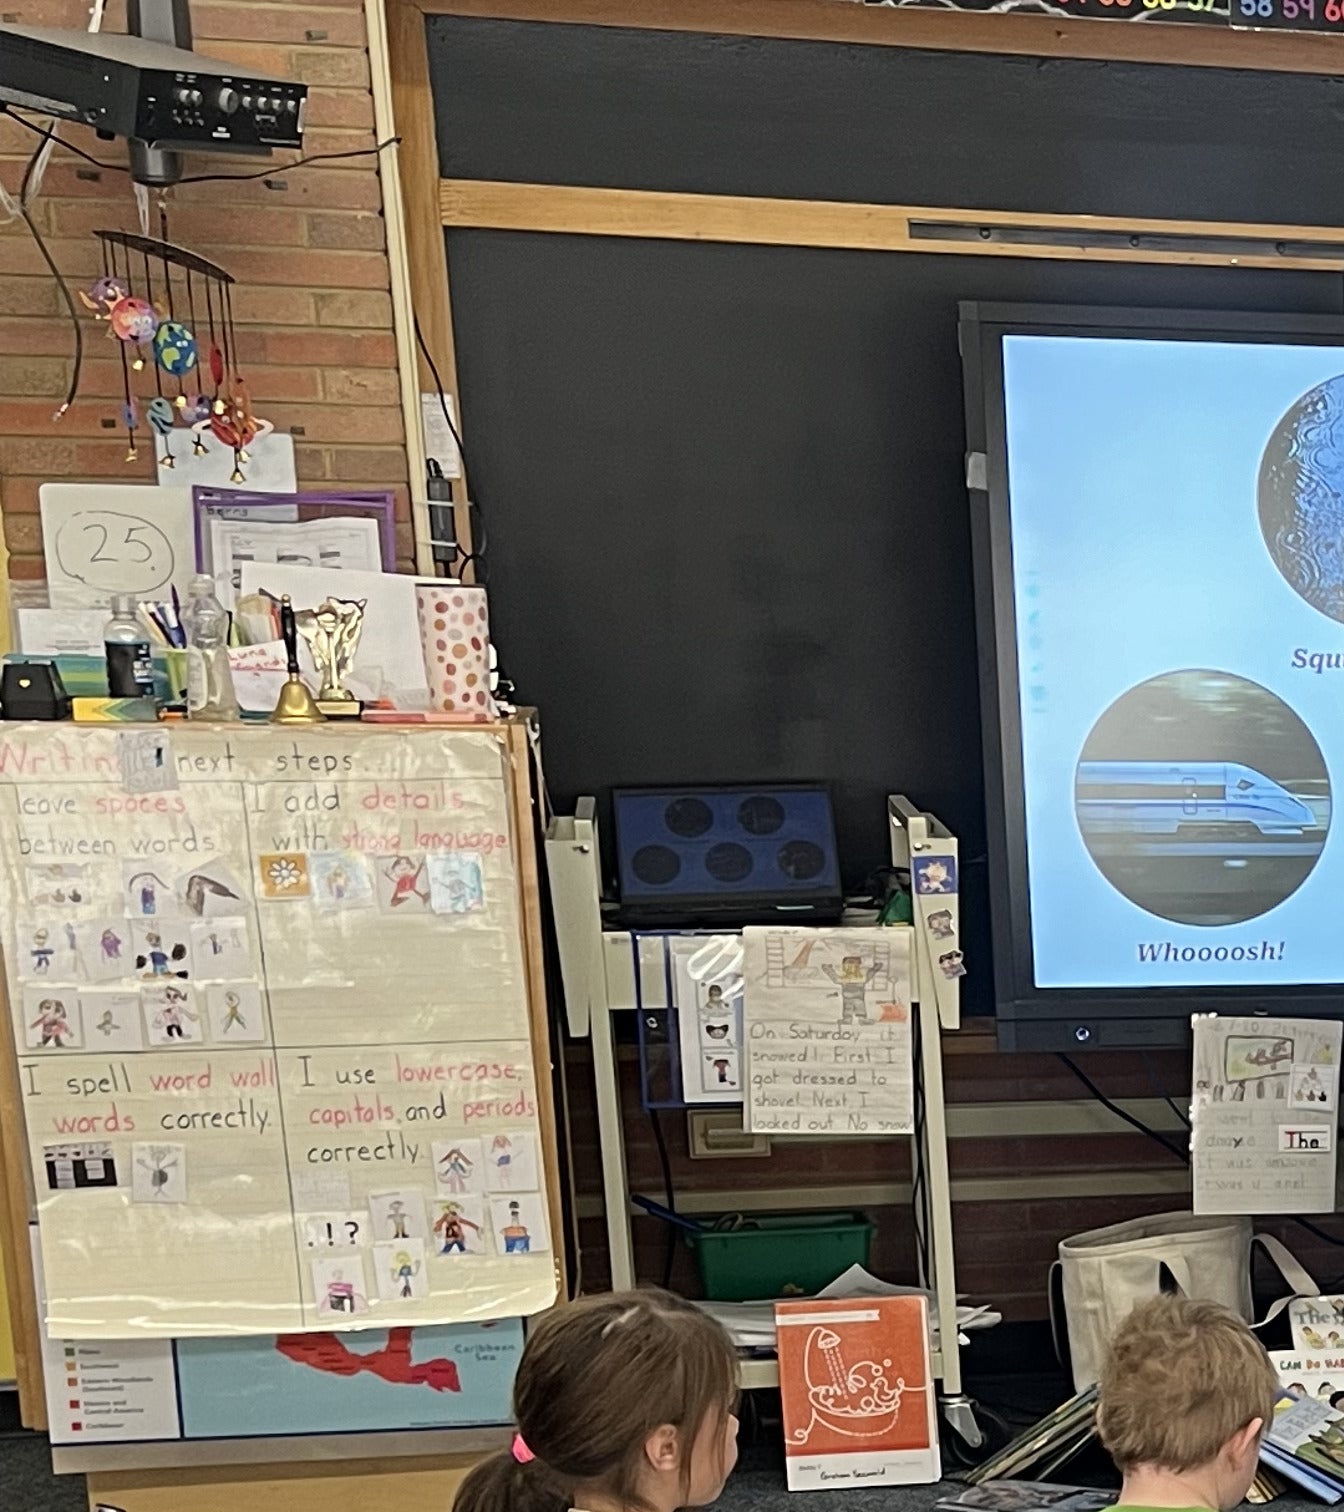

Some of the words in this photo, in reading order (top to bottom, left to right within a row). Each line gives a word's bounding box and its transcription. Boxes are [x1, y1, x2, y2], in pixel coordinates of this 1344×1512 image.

[0, 741, 120, 775] Writin
[178, 741, 235, 772] next
[16, 789, 77, 816] leave
[95, 795, 187, 821] spaces
[249, 781, 266, 813] I
[284, 783, 341, 814] add
[362, 782, 466, 811] details
[17, 824, 116, 855] between
[131, 821, 216, 852] words
[272, 819, 329, 852] with
[413, 819, 508, 853] language
[1138, 940, 1286, 963] Whoooosh!
[750, 1022, 776, 1039] On
[788, 1023, 861, 1043] Saturday
[833, 1045, 872, 1064] First
[886, 1047, 895, 1064] I
[22, 1063, 42, 1097] I
[66, 1062, 131, 1096] spell
[150, 1062, 212, 1092] word
[230, 1057, 277, 1089] wall
[297, 1055, 316, 1087] I
[335, 1067, 376, 1085] use
[752, 1069, 780, 1090] got
[792, 1069, 857, 1086] dressed
[871, 1070, 888, 1086] to
[405, 1091, 447, 1122] and
[462, 1088, 537, 1125] periods
[812, 1091, 848, 1108] Next
[858, 1091, 870, 1108] I
[52, 1102, 136, 1135] words
[808, 1114, 834, 1130] out
[848, 1113, 869, 1131] No
